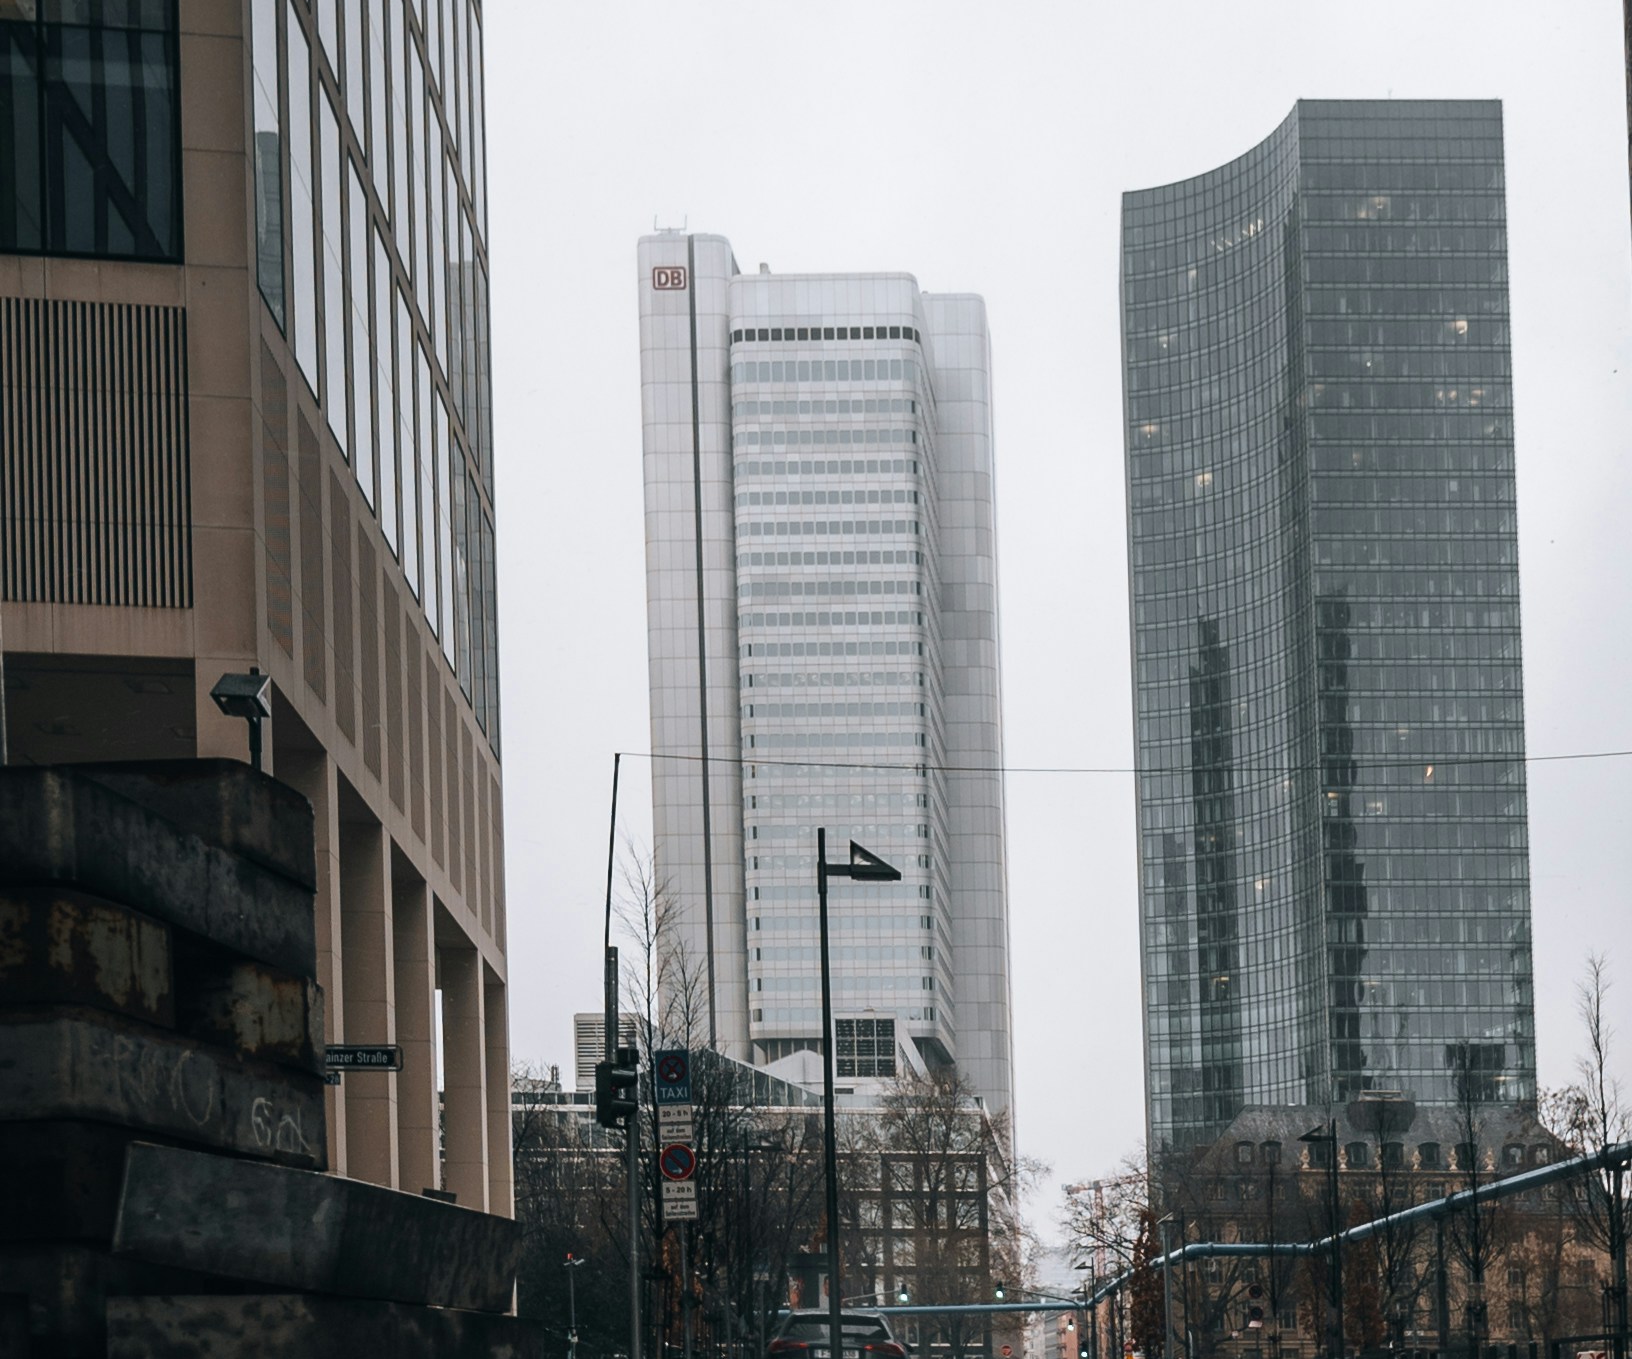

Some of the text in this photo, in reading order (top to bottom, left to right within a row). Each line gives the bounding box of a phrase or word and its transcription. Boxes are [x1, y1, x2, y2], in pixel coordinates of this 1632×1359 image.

[657, 269, 683, 287] DB
[326, 1051, 388, 1064] ainzer Straße
[660, 1087, 688, 1099] TAXI
